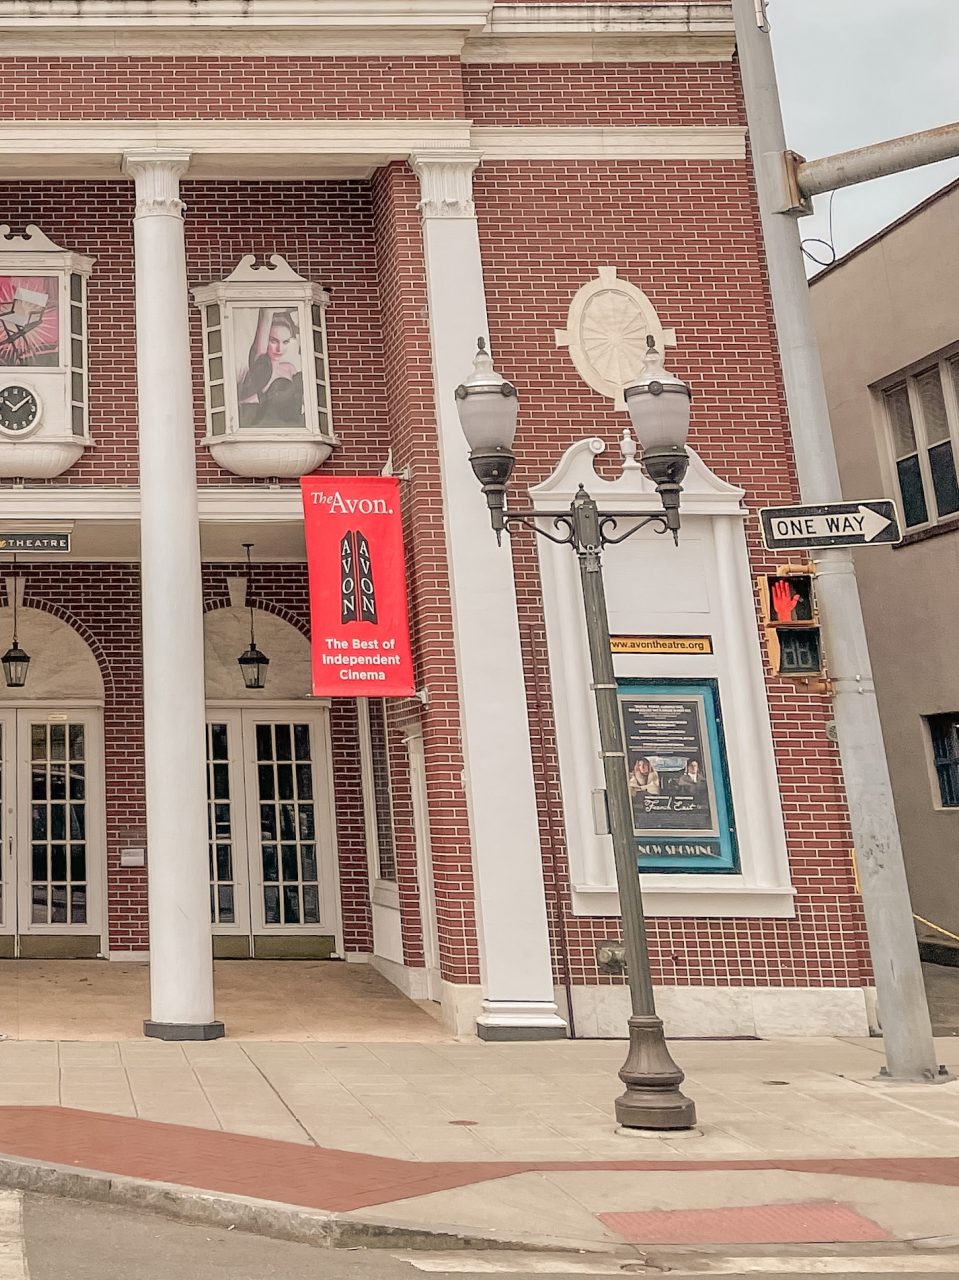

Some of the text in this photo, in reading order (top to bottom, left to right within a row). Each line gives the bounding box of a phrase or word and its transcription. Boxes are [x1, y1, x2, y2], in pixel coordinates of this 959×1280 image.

[311, 492, 334, 505] The
[777, 516, 865, 536] ONE WAY
[8, 539, 67, 547] THEATRE
[341, 540, 355, 615] AVON
[359, 540, 375, 615] AVON
[325, 638, 395, 650] The Best of
[322, 654, 401, 667] Independent
[339, 670, 386, 681] Cinema
[638, 845, 713, 856] NOW SHOWING
